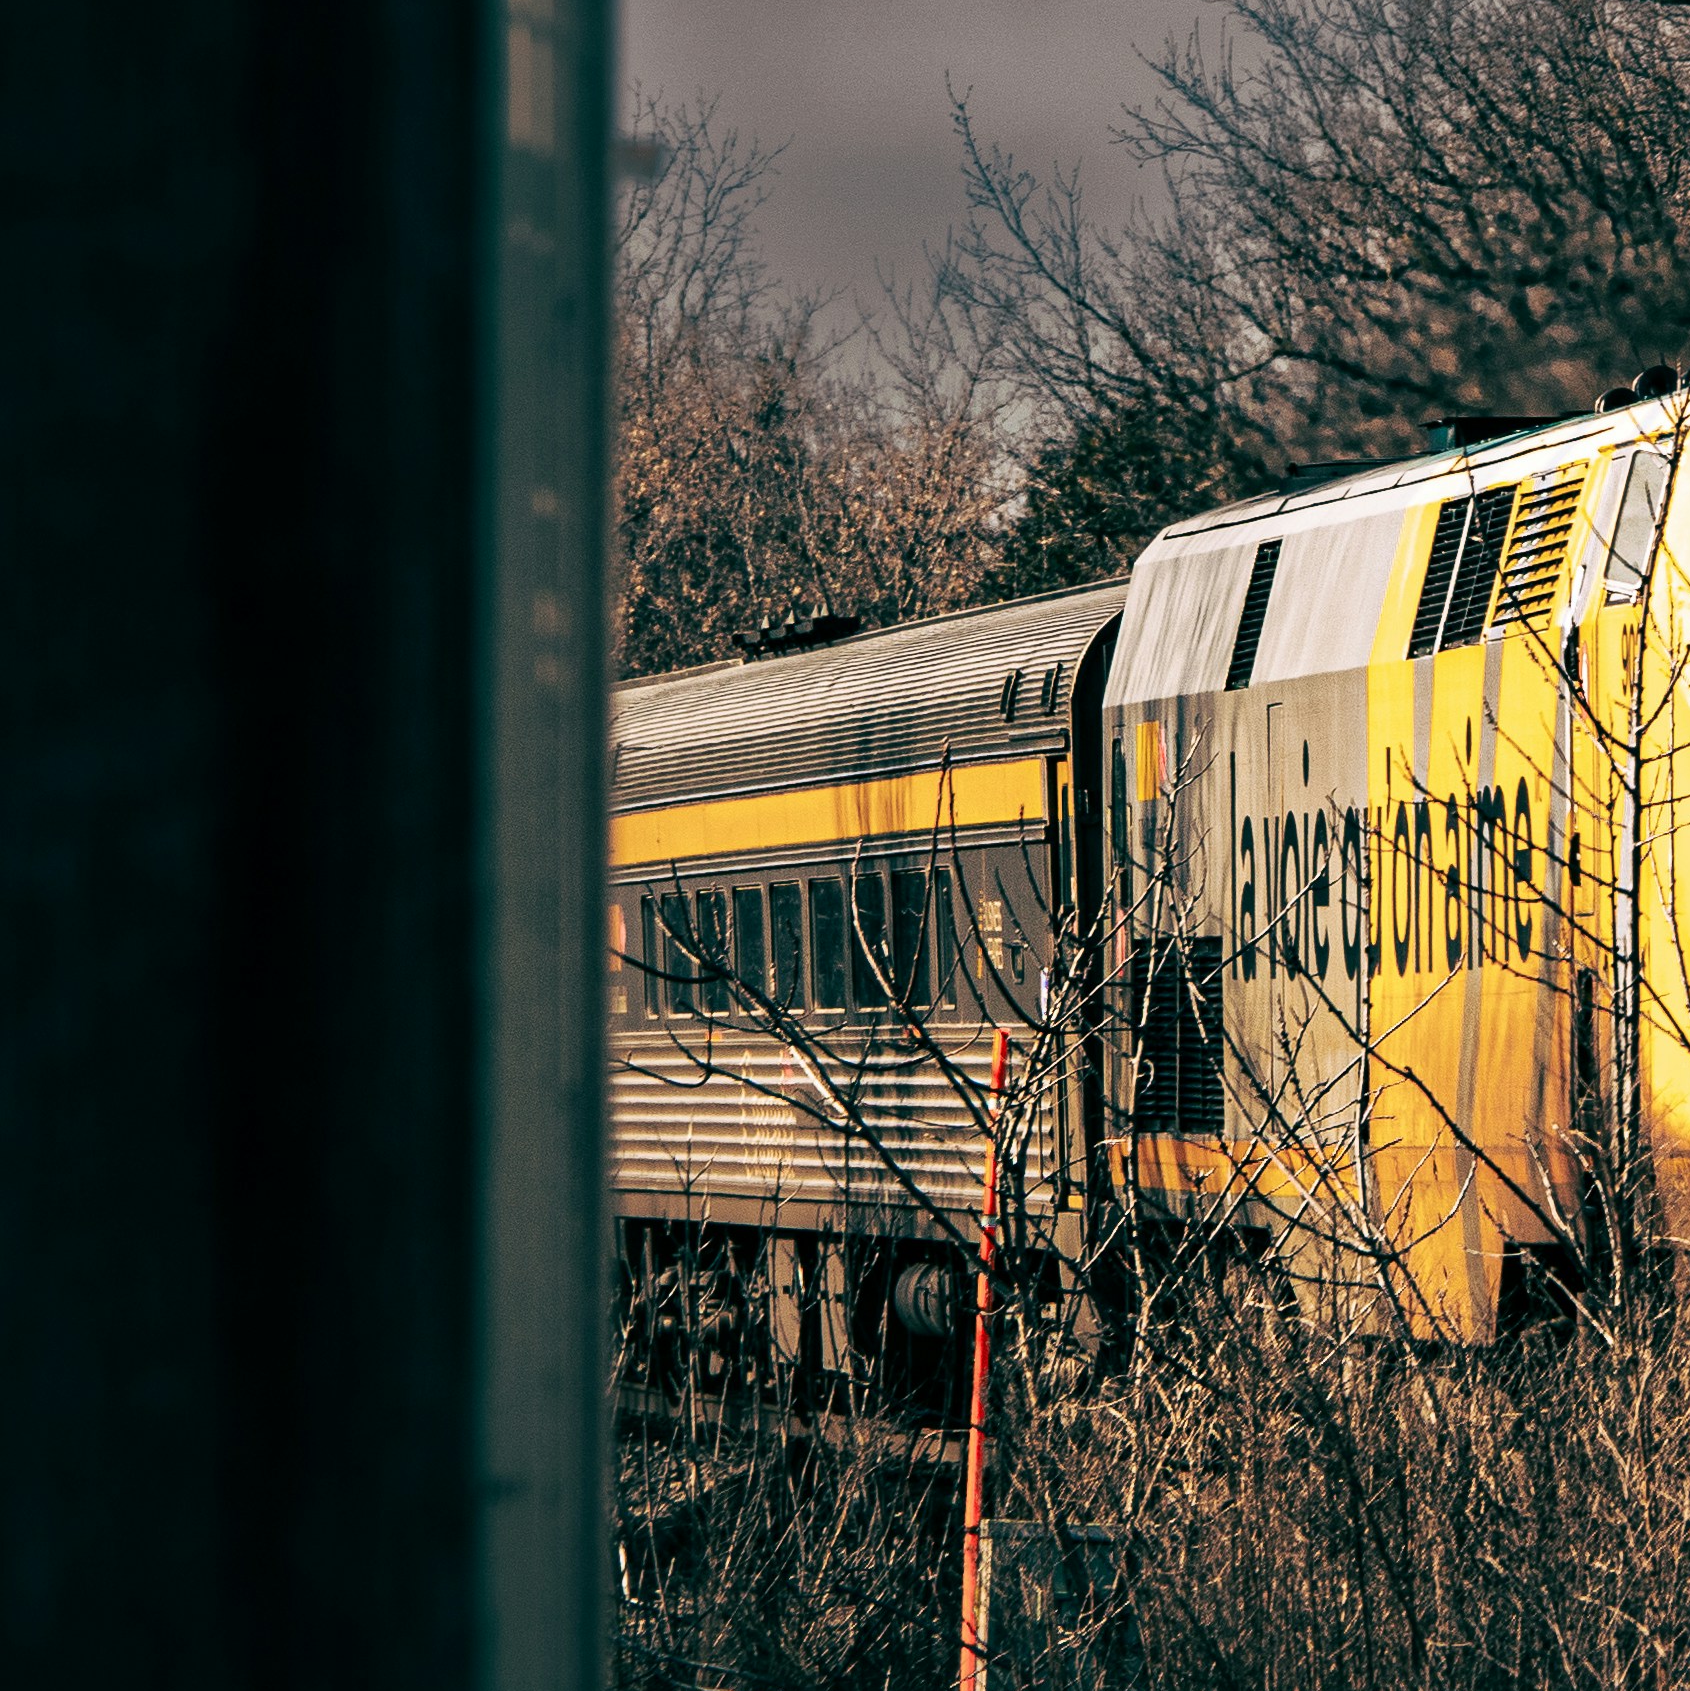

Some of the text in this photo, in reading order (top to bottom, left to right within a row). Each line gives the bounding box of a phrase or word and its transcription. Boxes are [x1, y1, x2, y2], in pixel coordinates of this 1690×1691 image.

[1230, 716, 1532, 1036] la voie qu'on aime
